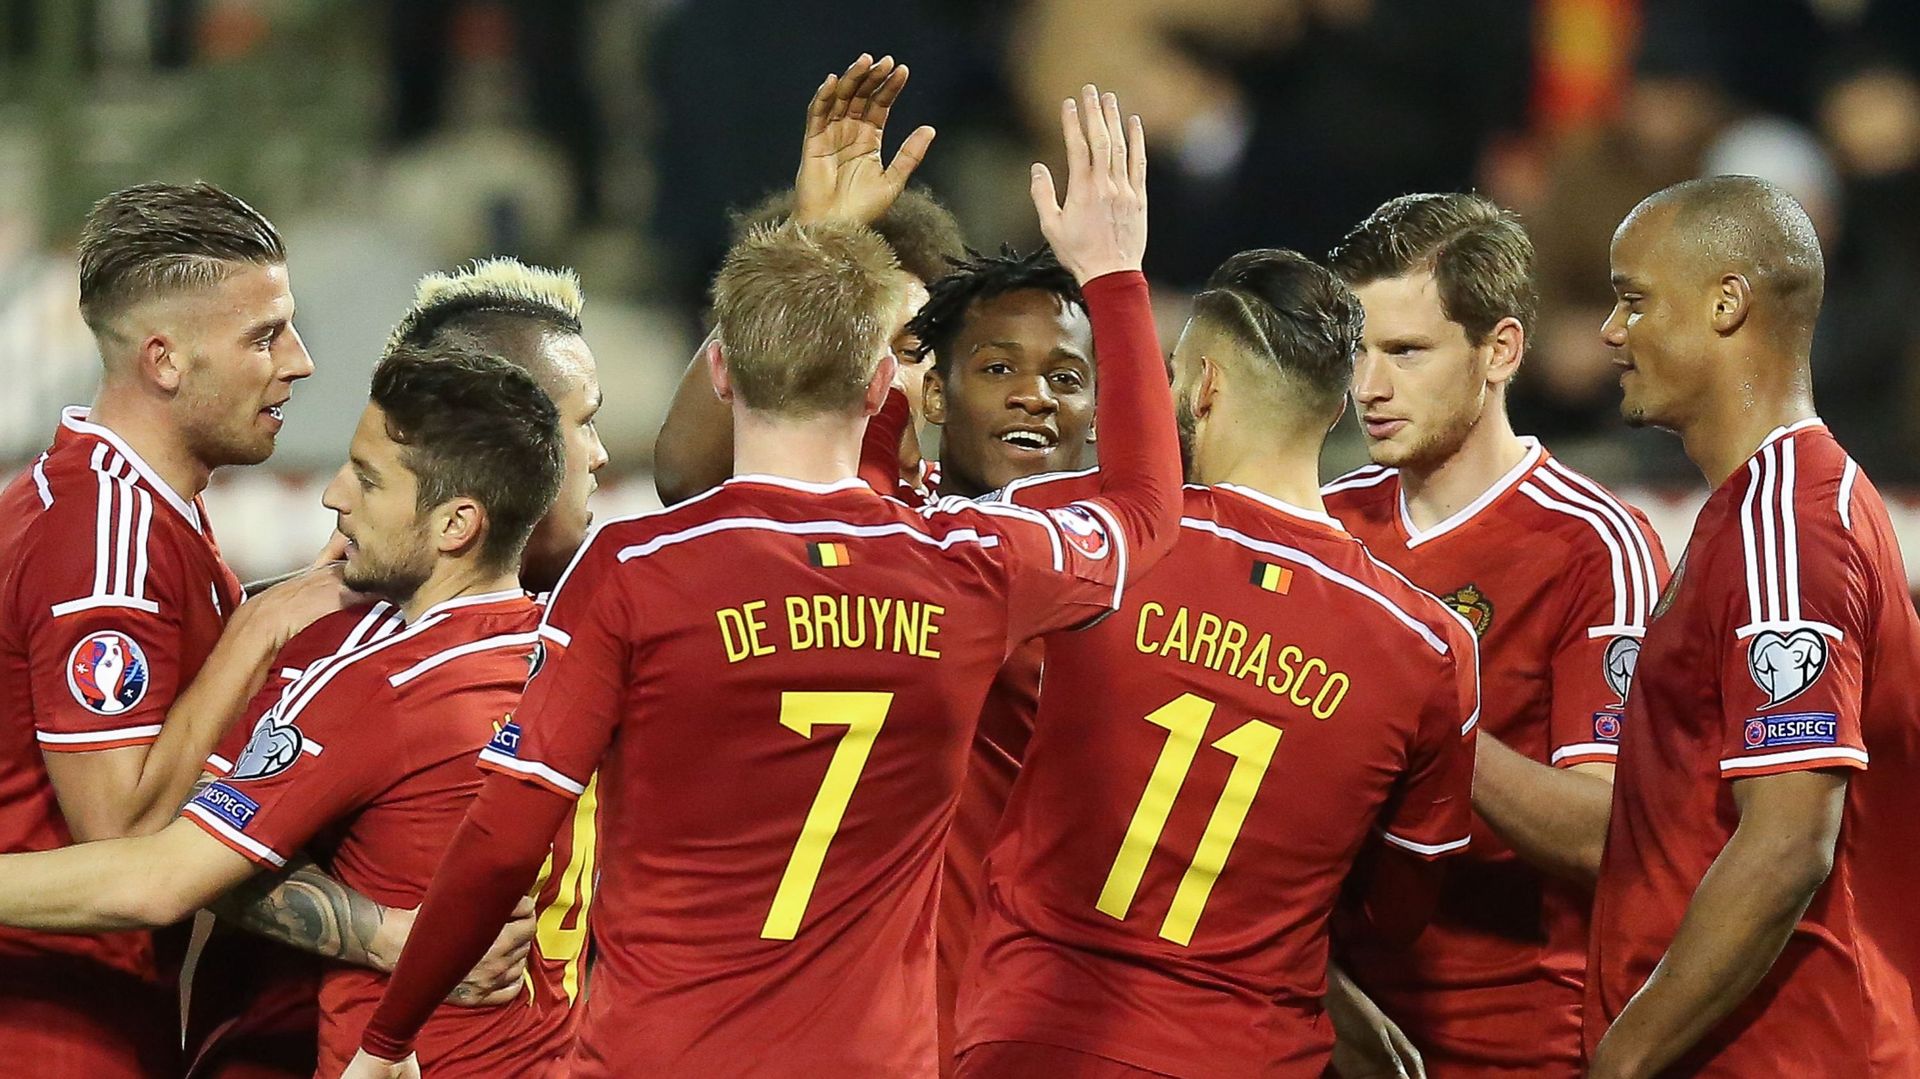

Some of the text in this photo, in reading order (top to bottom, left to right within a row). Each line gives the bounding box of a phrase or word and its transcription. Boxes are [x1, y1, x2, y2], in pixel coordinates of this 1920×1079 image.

[716, 594, 945, 663] DE BRUYNE
[1135, 601, 1351, 721] CARRASCO
[1767, 721, 1836, 738] RESPECT
[759, 691, 895, 941] 7
[1095, 692, 1284, 947] 11
